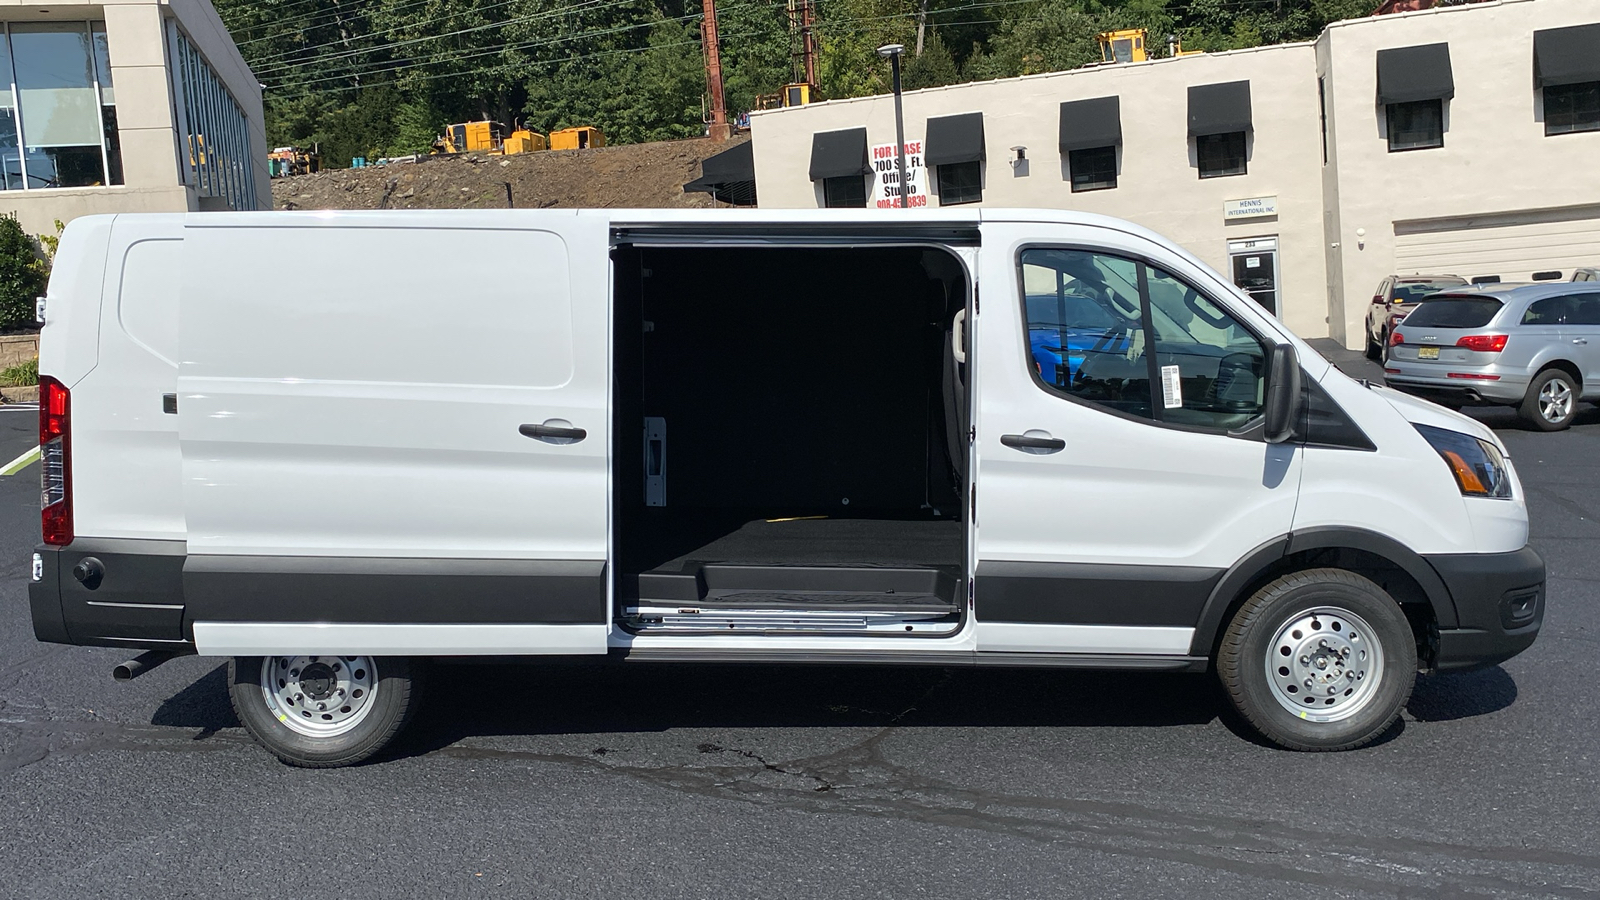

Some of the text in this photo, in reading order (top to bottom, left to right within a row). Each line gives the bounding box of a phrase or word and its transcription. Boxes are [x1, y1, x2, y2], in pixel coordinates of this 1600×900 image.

[874, 142, 921, 159] FOR LASE
[874, 156, 922, 172] 700 S. Ft.
[882, 169, 916, 184] Offie/
[884, 184, 916, 197] Stuio
[876, 195, 926, 208] 908-458839
[1228, 208, 1265, 216] INTERNATIONAL
